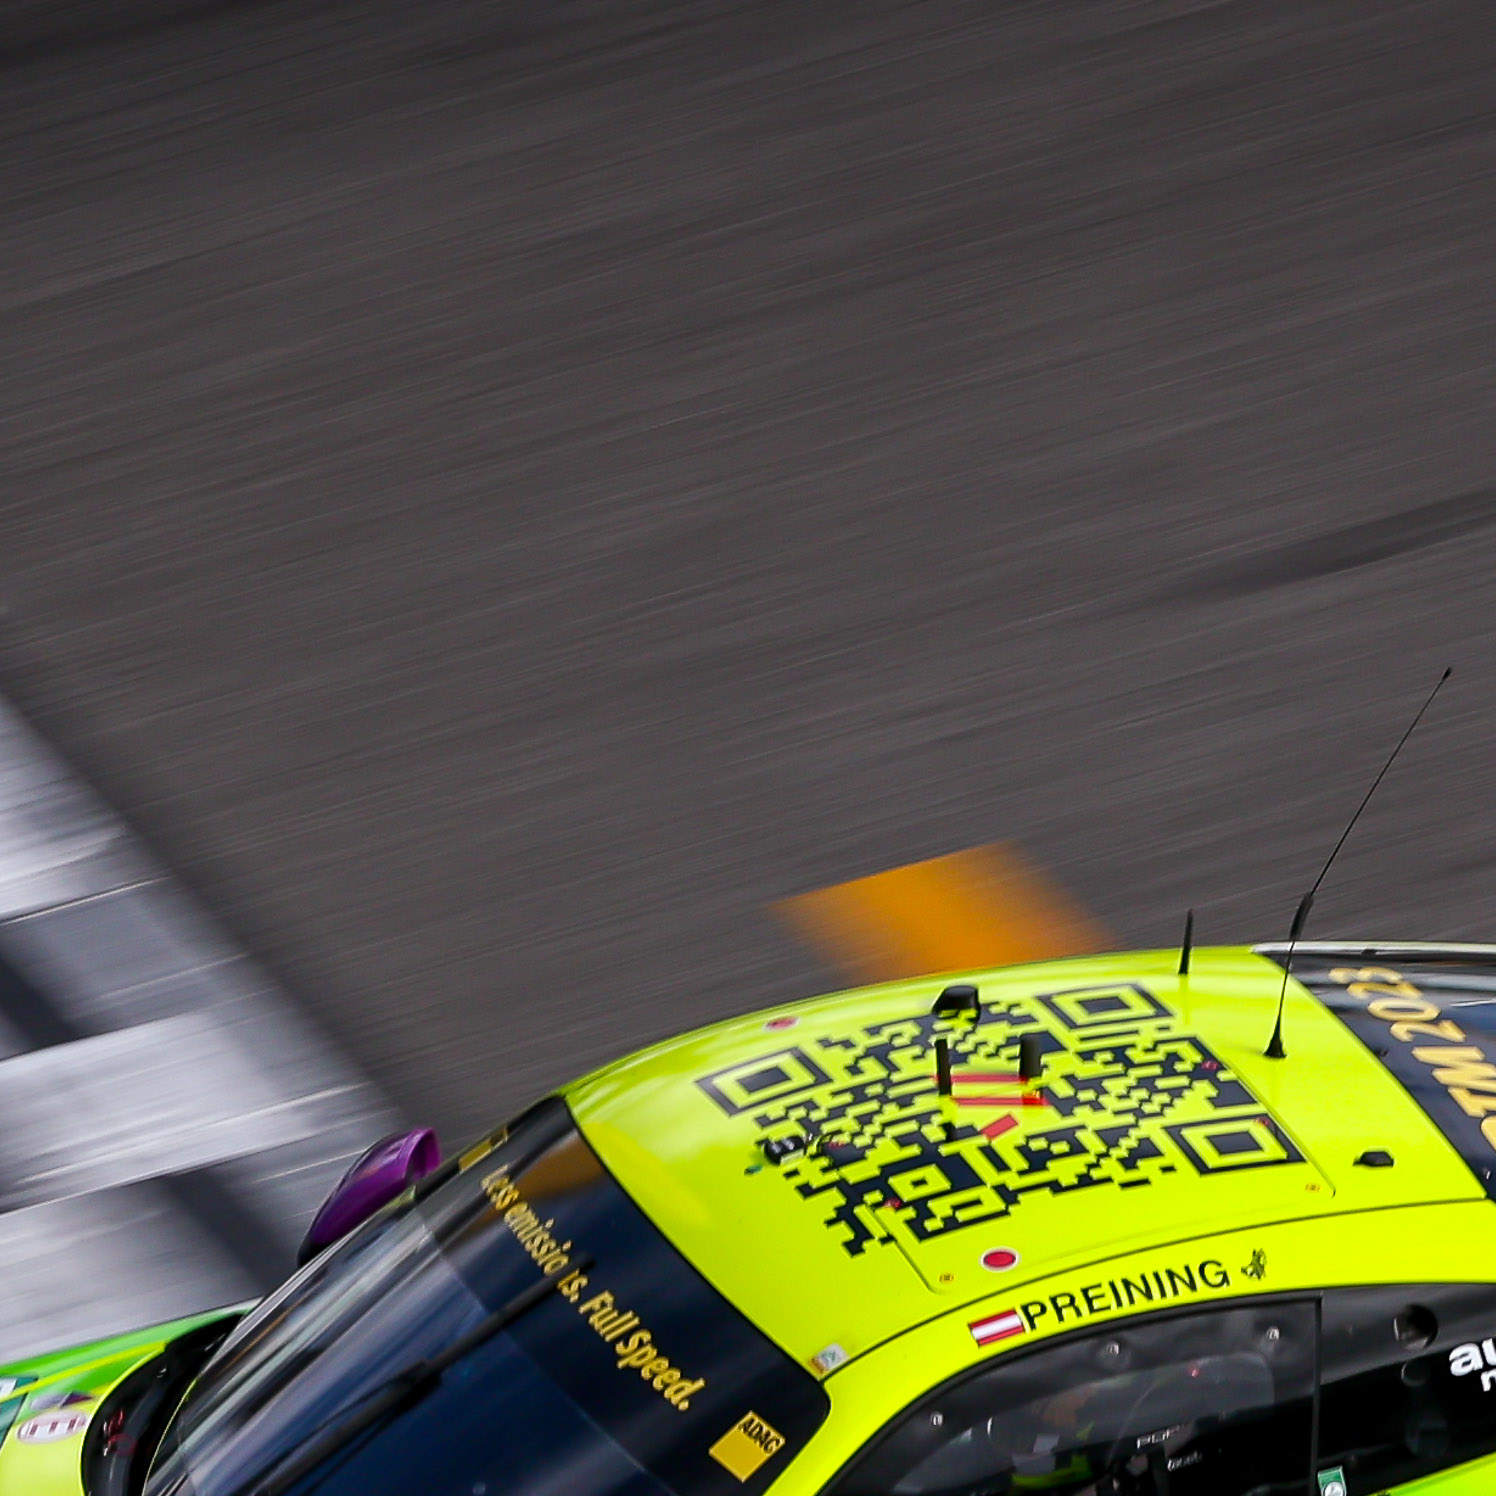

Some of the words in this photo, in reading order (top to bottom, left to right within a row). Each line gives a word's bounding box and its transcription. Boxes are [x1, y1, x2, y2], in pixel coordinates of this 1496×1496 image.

[1328, 966, 1467, 1043] 2023
[1020, 1260, 1231, 1331] PREINING
[578, 1290, 640, 1343] Full
[615, 1329, 705, 1411] Speed.
